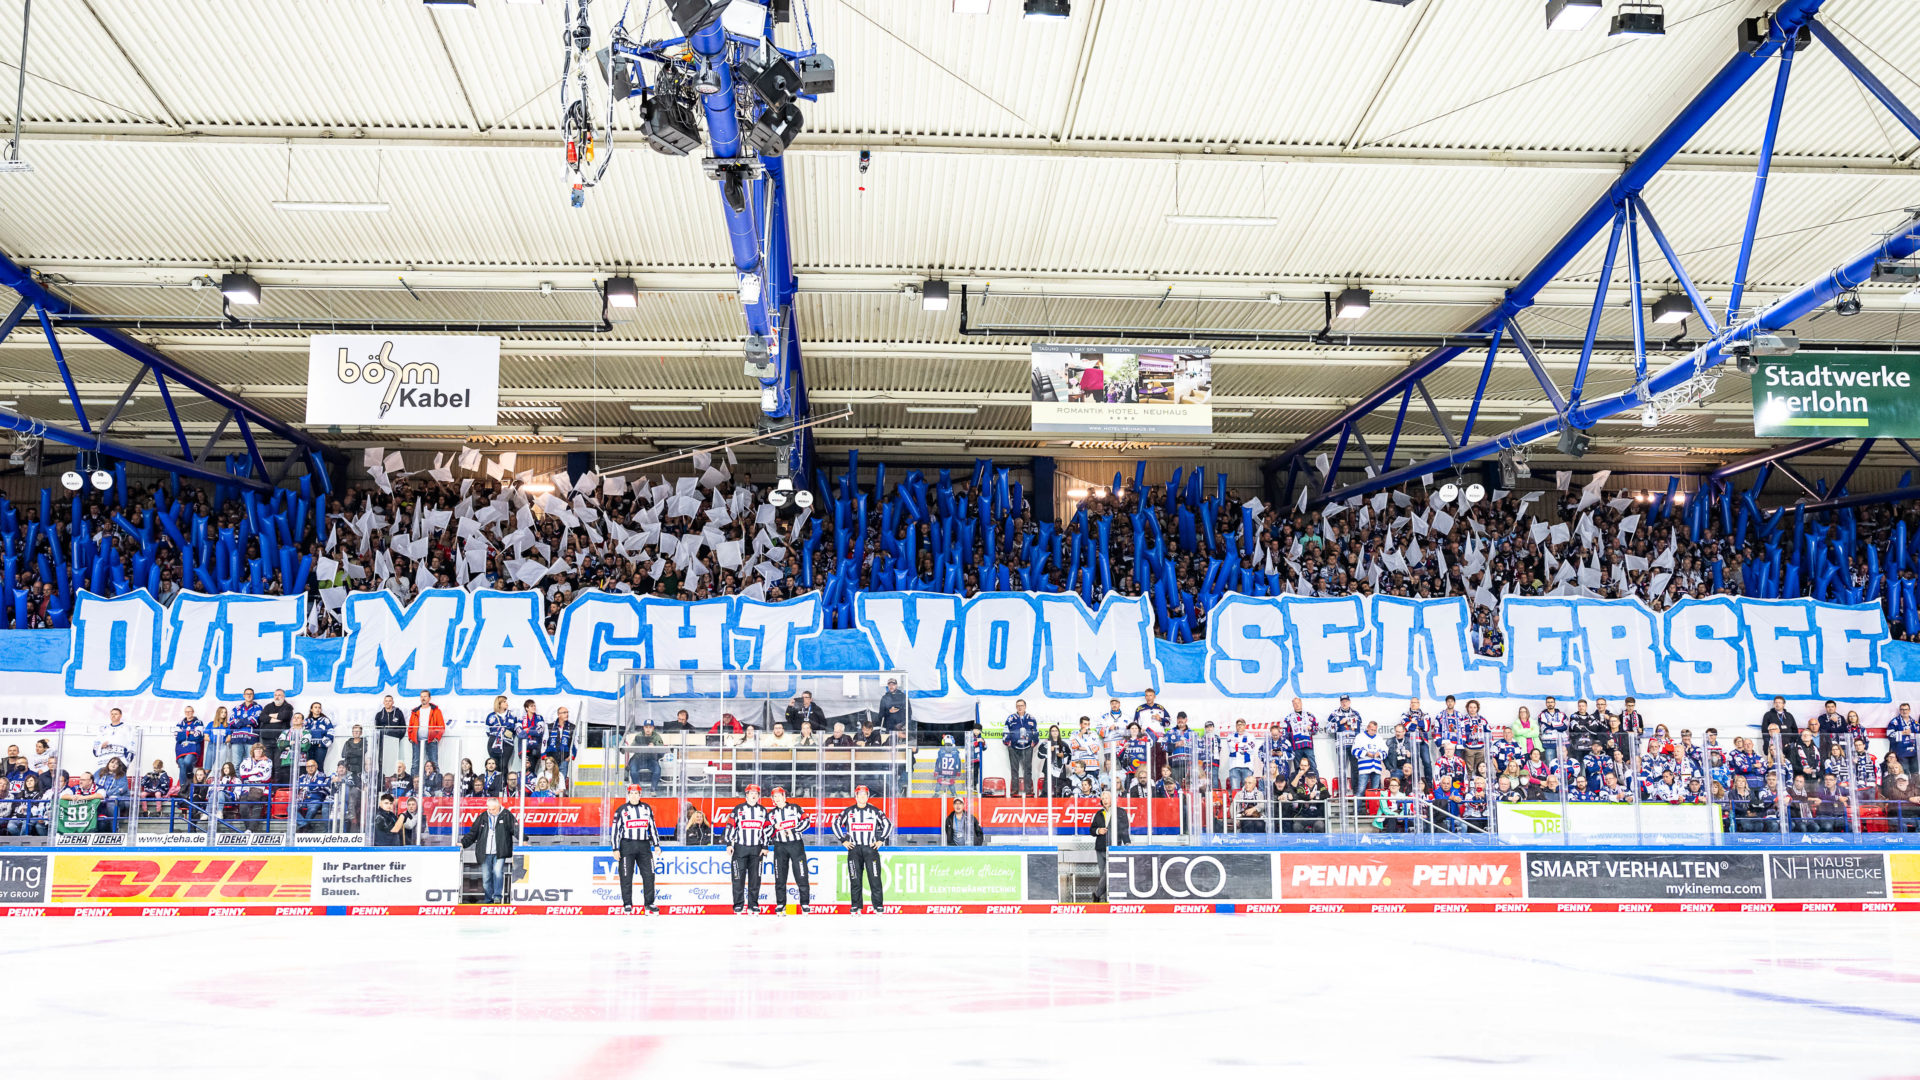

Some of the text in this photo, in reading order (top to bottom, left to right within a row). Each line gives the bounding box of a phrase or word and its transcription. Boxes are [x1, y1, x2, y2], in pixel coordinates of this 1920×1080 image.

[338, 341, 440, 414] böhm
[1765, 365, 1911, 387] Stadtwerke
[400, 388, 471, 408] Kabel
[65, 586, 1891, 703] DIE MACHT VOM SEILERSEE
[941, 757, 955, 770] 82
[67, 805, 88, 821] 98
[59, 835, 123, 844] JDEHA JDEHA
[138, 835, 205, 844] www.jdeha.de
[219, 835, 282, 844] JDEHA JDEHA
[296, 835, 363, 844] www.jdeha.de
[323, 862, 406, 871] Ihr Partner für
[634, 856, 731, 875] ärkische
[1530, 860, 1601, 878] SMART
[1772, 857, 1811, 880] NH
[1813, 857, 1862, 867] NAUST
[86, 860, 277, 898] DHL
[322, 874, 412, 883] wirtschaftliches
[1292, 864, 1512, 886] PENNY. PENNY.
[1814, 868, 1882, 879] HUNECKE
[321, 887, 360, 896] Bauen.
[1666, 882, 1762, 896] mykinema.com
